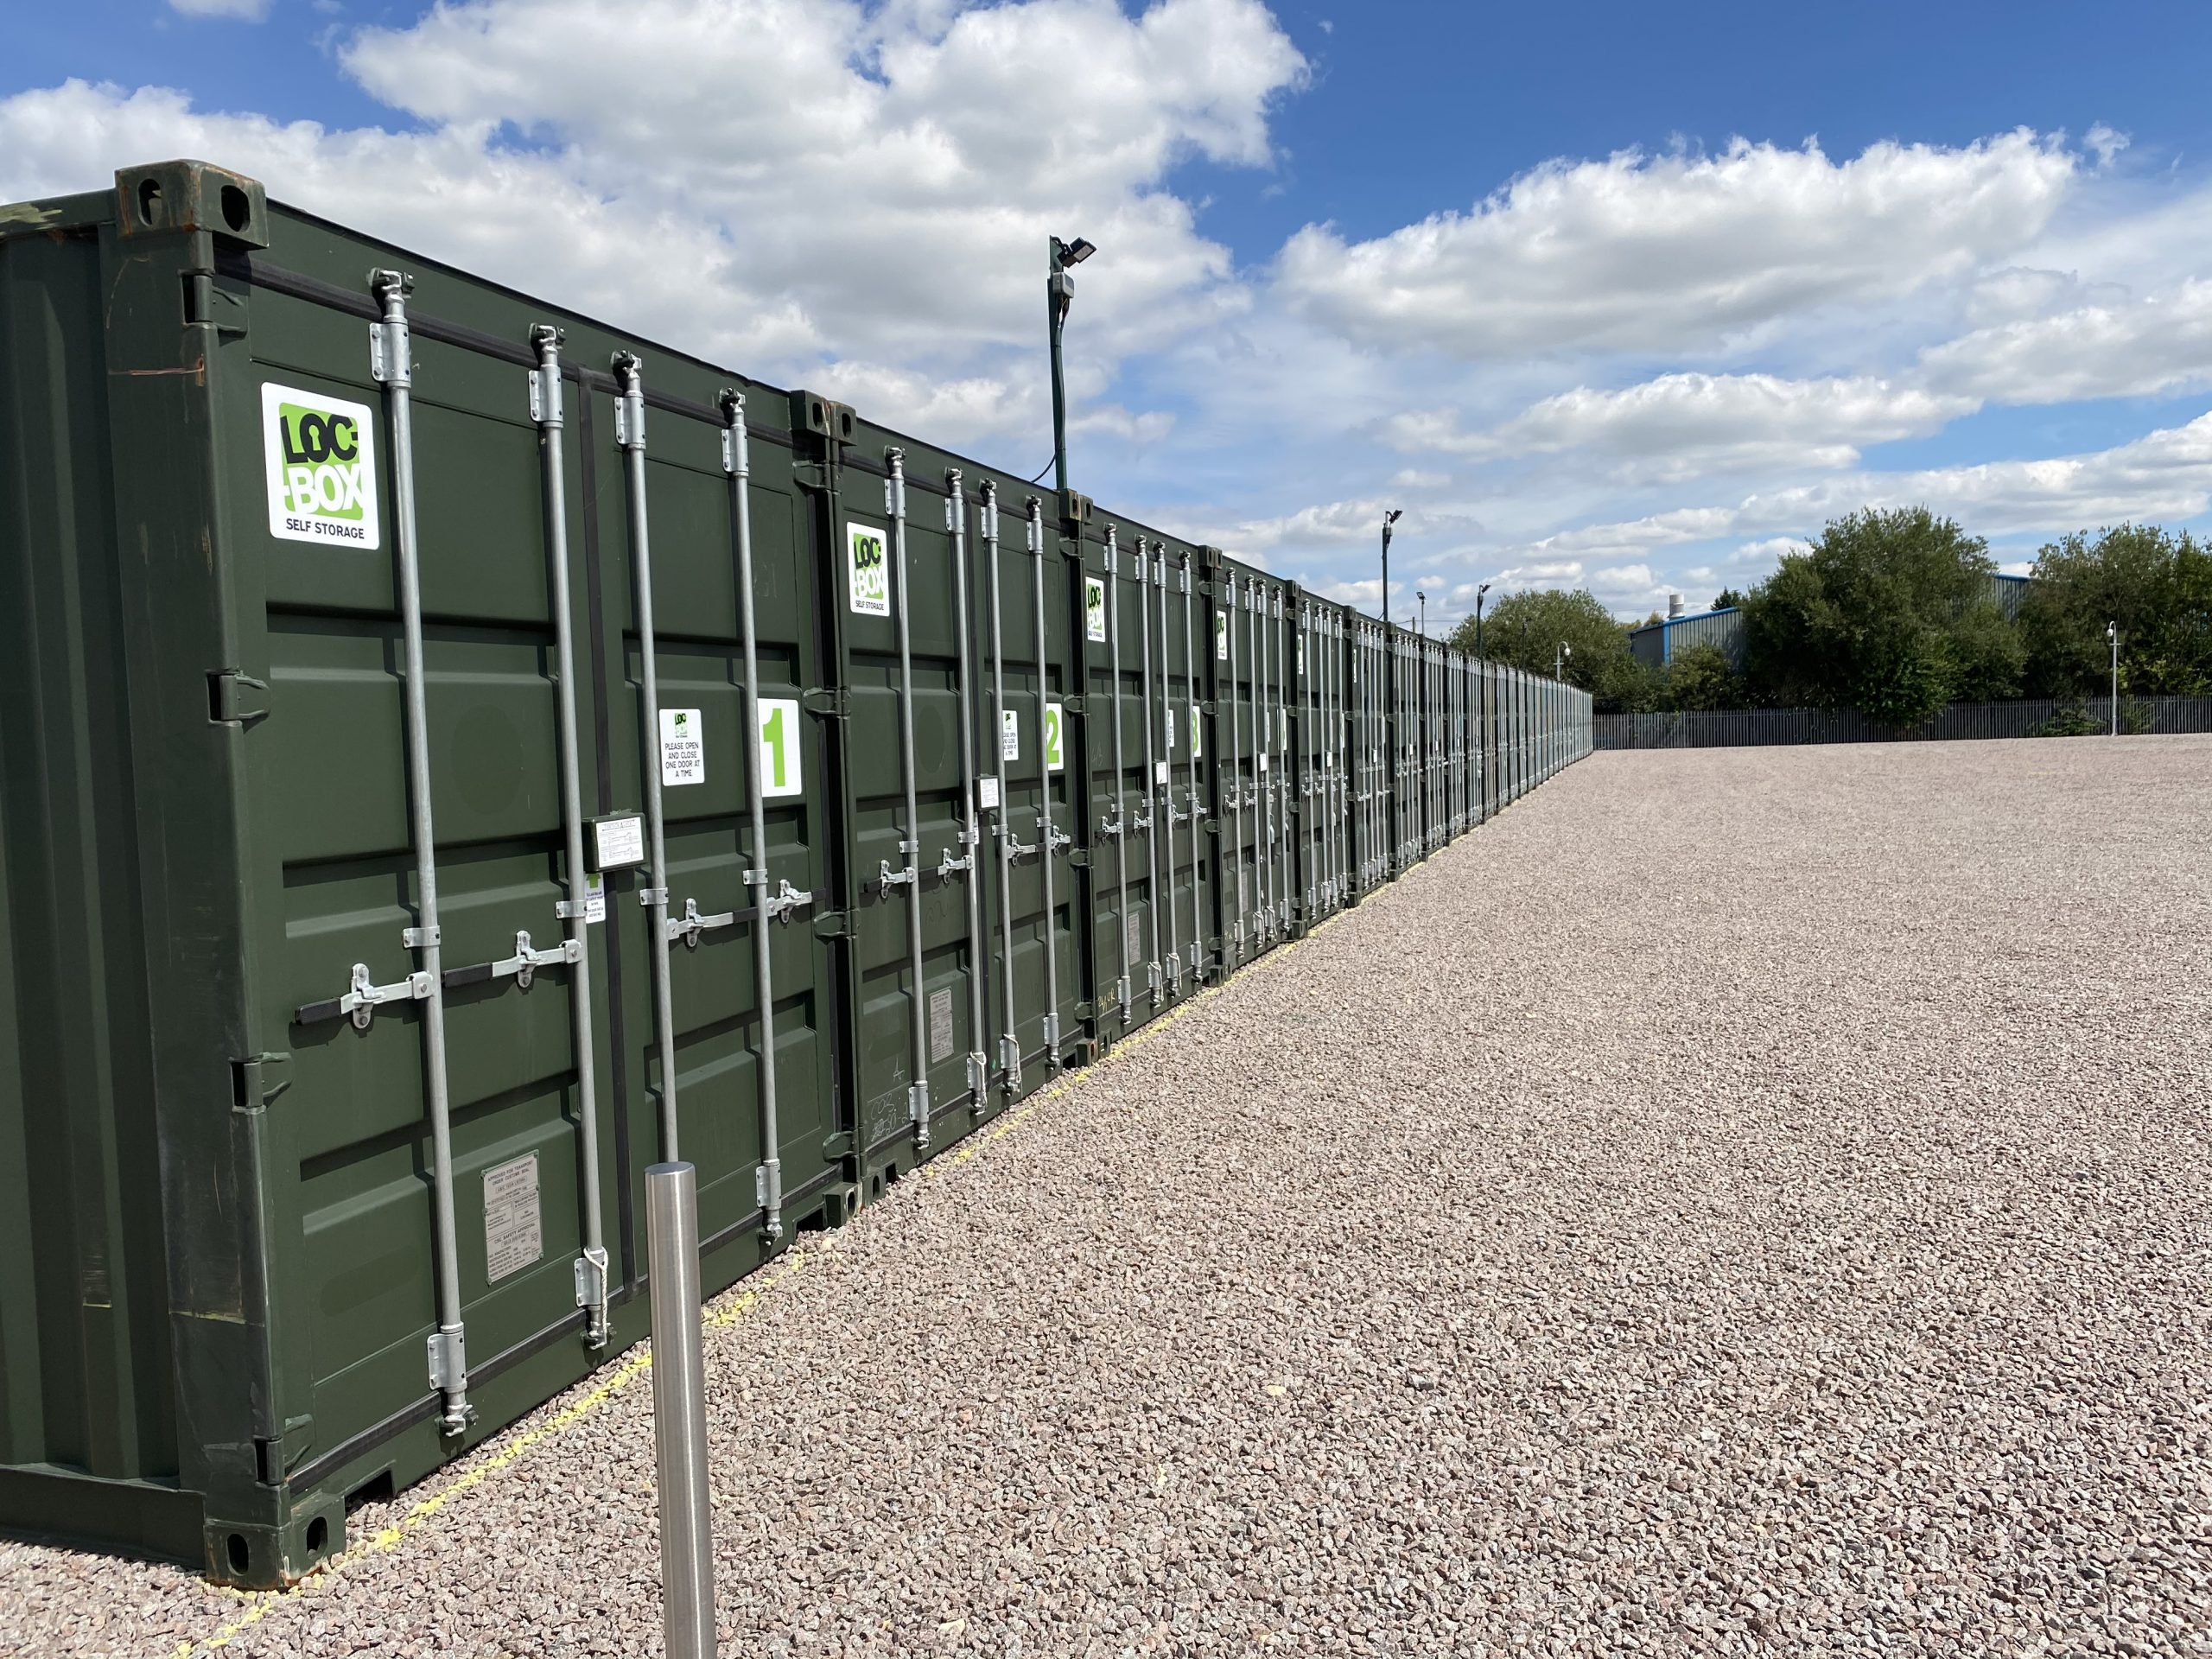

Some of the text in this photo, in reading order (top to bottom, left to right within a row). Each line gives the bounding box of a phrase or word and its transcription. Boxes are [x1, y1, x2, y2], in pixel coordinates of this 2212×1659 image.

[284, 463, 364, 514] BOX
[286, 518, 365, 540] SELF STORAGE
[855, 566, 883, 598] BOX
[855, 600, 885, 611] SELF STORAGE
[762, 708, 786, 787] 1
[1046, 709, 1060, 764] 2
[665, 760, 677, 769] ONE
[677, 760, 693, 768] DOOR
[487, 1171, 506, 1182] APPROVED
[514, 1160, 533, 1171] TRANSPORT
[503, 1230, 517, 1241] SAFETY
[517, 1222, 536, 1234] APPROVAL
